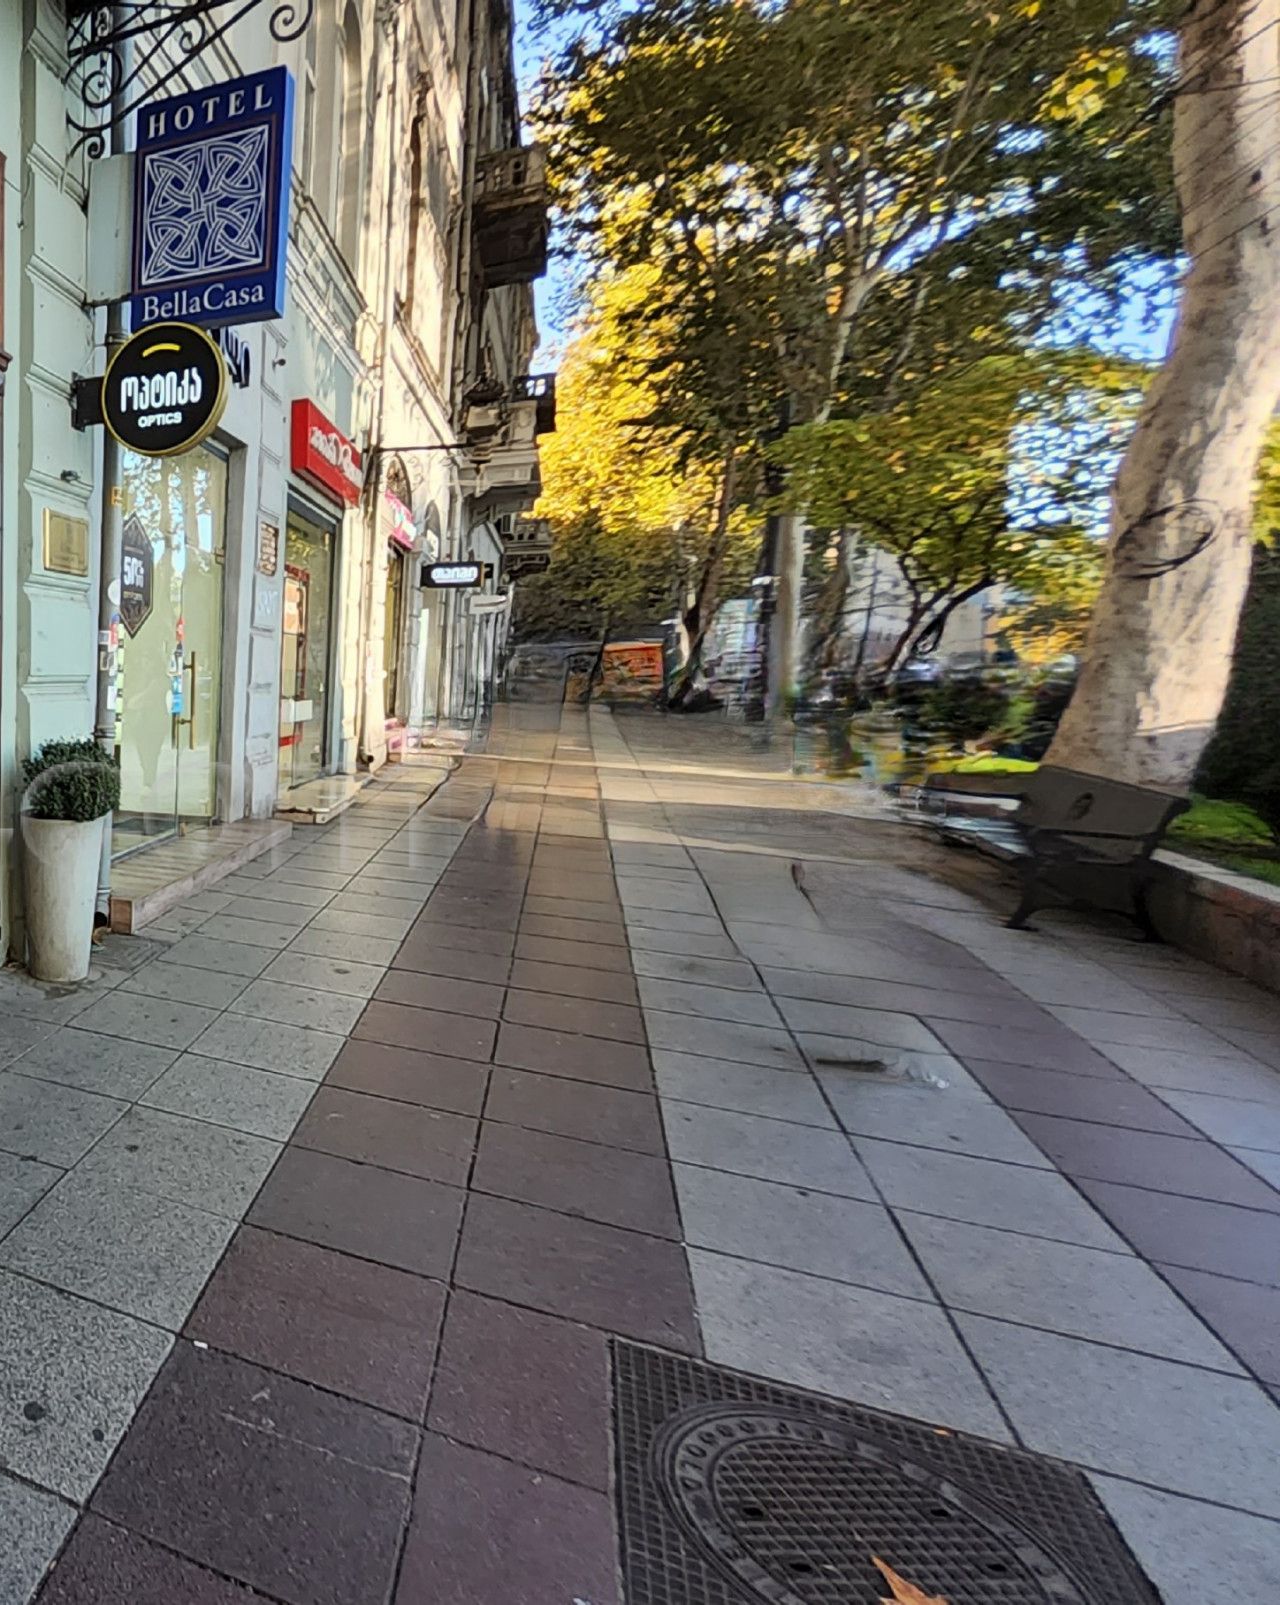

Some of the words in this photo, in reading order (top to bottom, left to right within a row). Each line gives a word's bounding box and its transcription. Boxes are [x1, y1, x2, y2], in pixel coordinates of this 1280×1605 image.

[148, 84, 272, 139] HOTEL
[142, 283, 265, 322] BellaCasa
[120, 366, 203, 413] ოპტიკა
[138, 411, 183, 428] OPTICS
